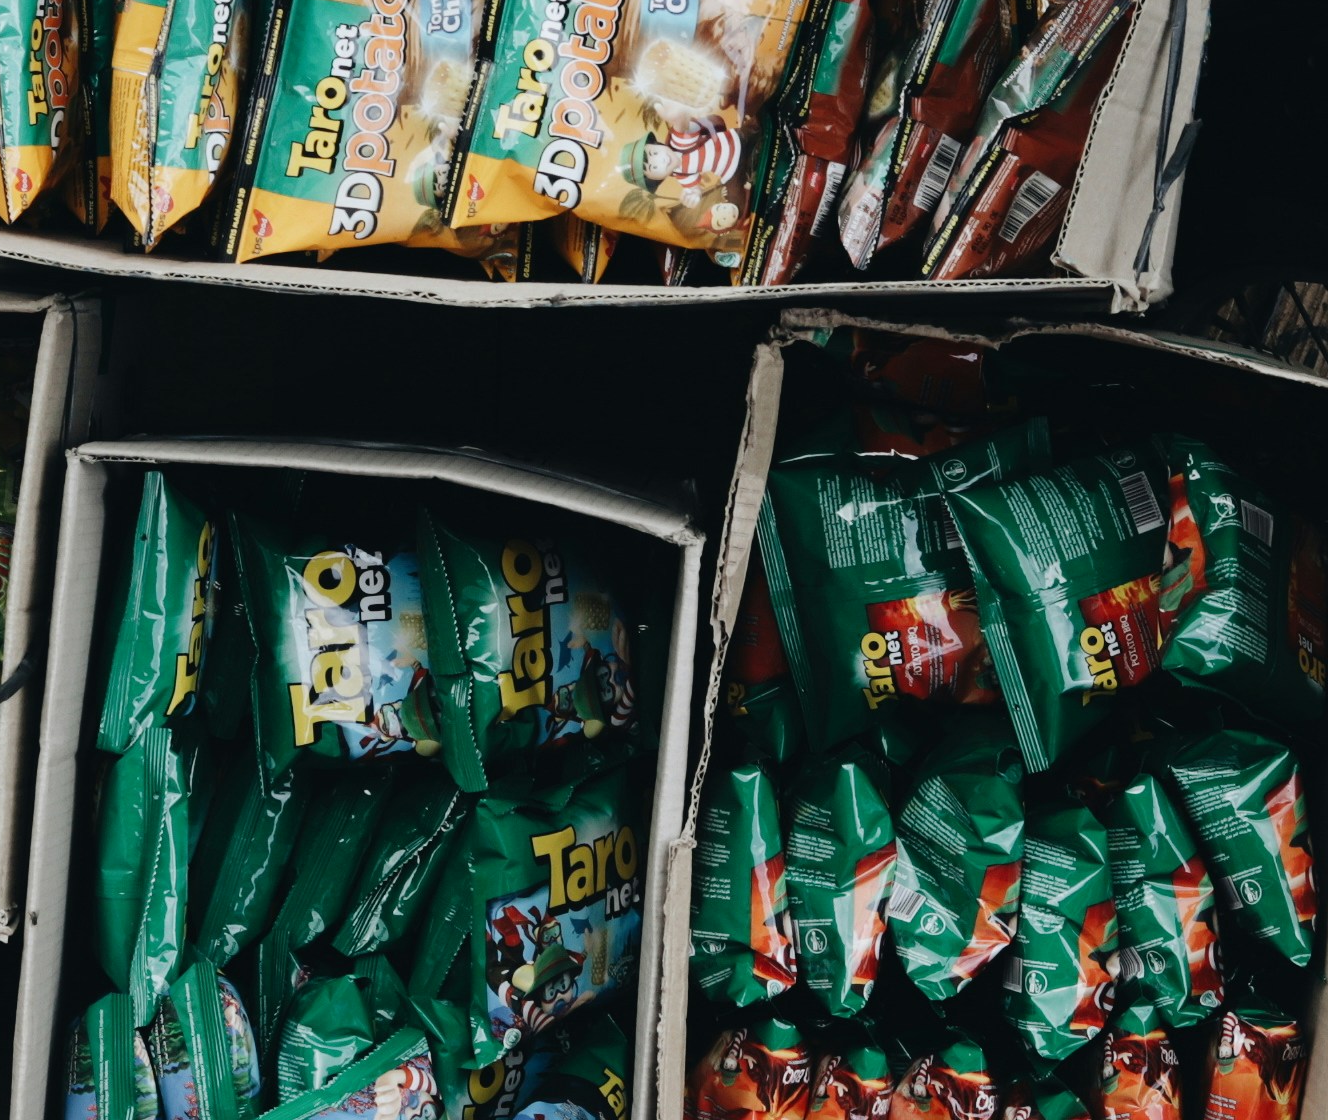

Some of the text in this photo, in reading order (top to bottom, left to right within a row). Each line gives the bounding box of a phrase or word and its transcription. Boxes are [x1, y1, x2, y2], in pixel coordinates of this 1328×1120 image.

[27, 28, 49, 127] Taro
[184, 43, 224, 151] Taro
[286, 22, 359, 179] Taro net
[492, 36, 555, 141] Taro
[1001, 59, 1027, 88] MAKANAN
[328, 171, 385, 240] 3D
[466, 197, 476, 218] tps
[533, 138, 589, 209] 3D
[251, 233, 263, 256] tps
[165, 520, 212, 718] Taro
[287, 544, 392, 748] Taro net
[496, 537, 552, 725] Taro
[1078, 621, 1122, 708] Taro net
[1118, 614, 1141, 668] POTATO BBQ
[861, 630, 904, 710] Taro net
[530, 825, 640, 913] Taro
[603, 870, 642, 921] net
